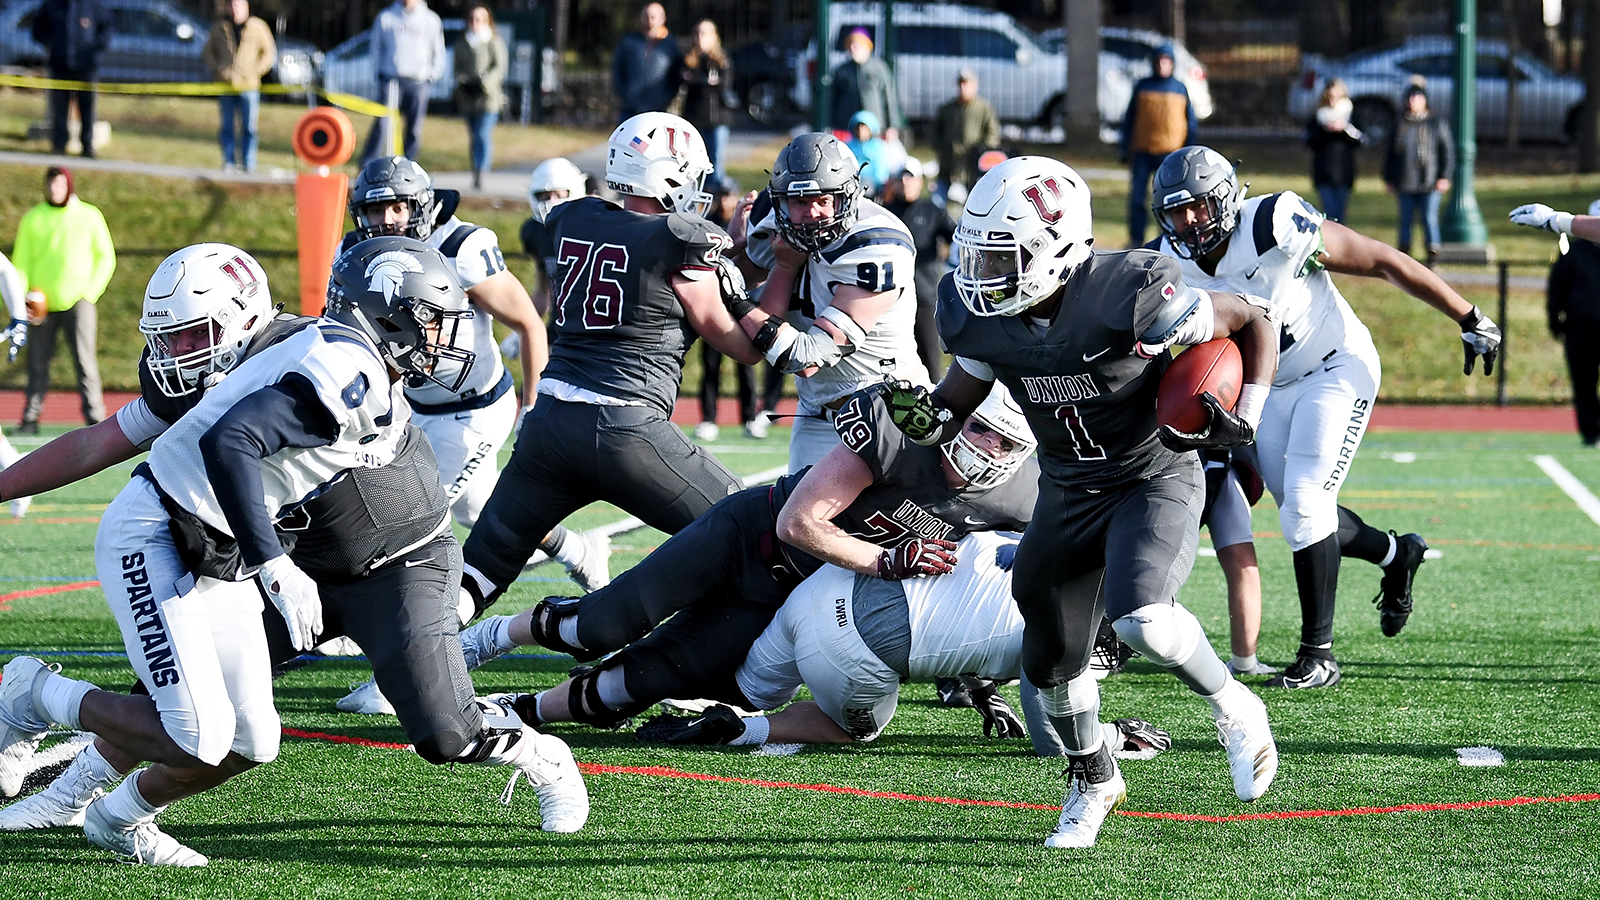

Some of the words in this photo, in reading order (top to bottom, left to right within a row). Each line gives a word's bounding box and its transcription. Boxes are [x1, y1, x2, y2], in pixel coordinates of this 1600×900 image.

[1022, 176, 1065, 225] U
[556, 236, 630, 331] 76
[856, 261, 896, 292] 91
[147, 310, 169, 318] FAMILY
[340, 371, 370, 409] 8
[1021, 373, 1101, 403] UNION
[834, 398, 872, 453] 79
[1055, 404, 1107, 461] 1
[1323, 398, 1368, 492] SPARTANS
[447, 441, 492, 500] RTANS
[892, 499, 955, 542] UNION
[121, 551, 180, 689] SPARTANS
[835, 598, 848, 627] CWRU
